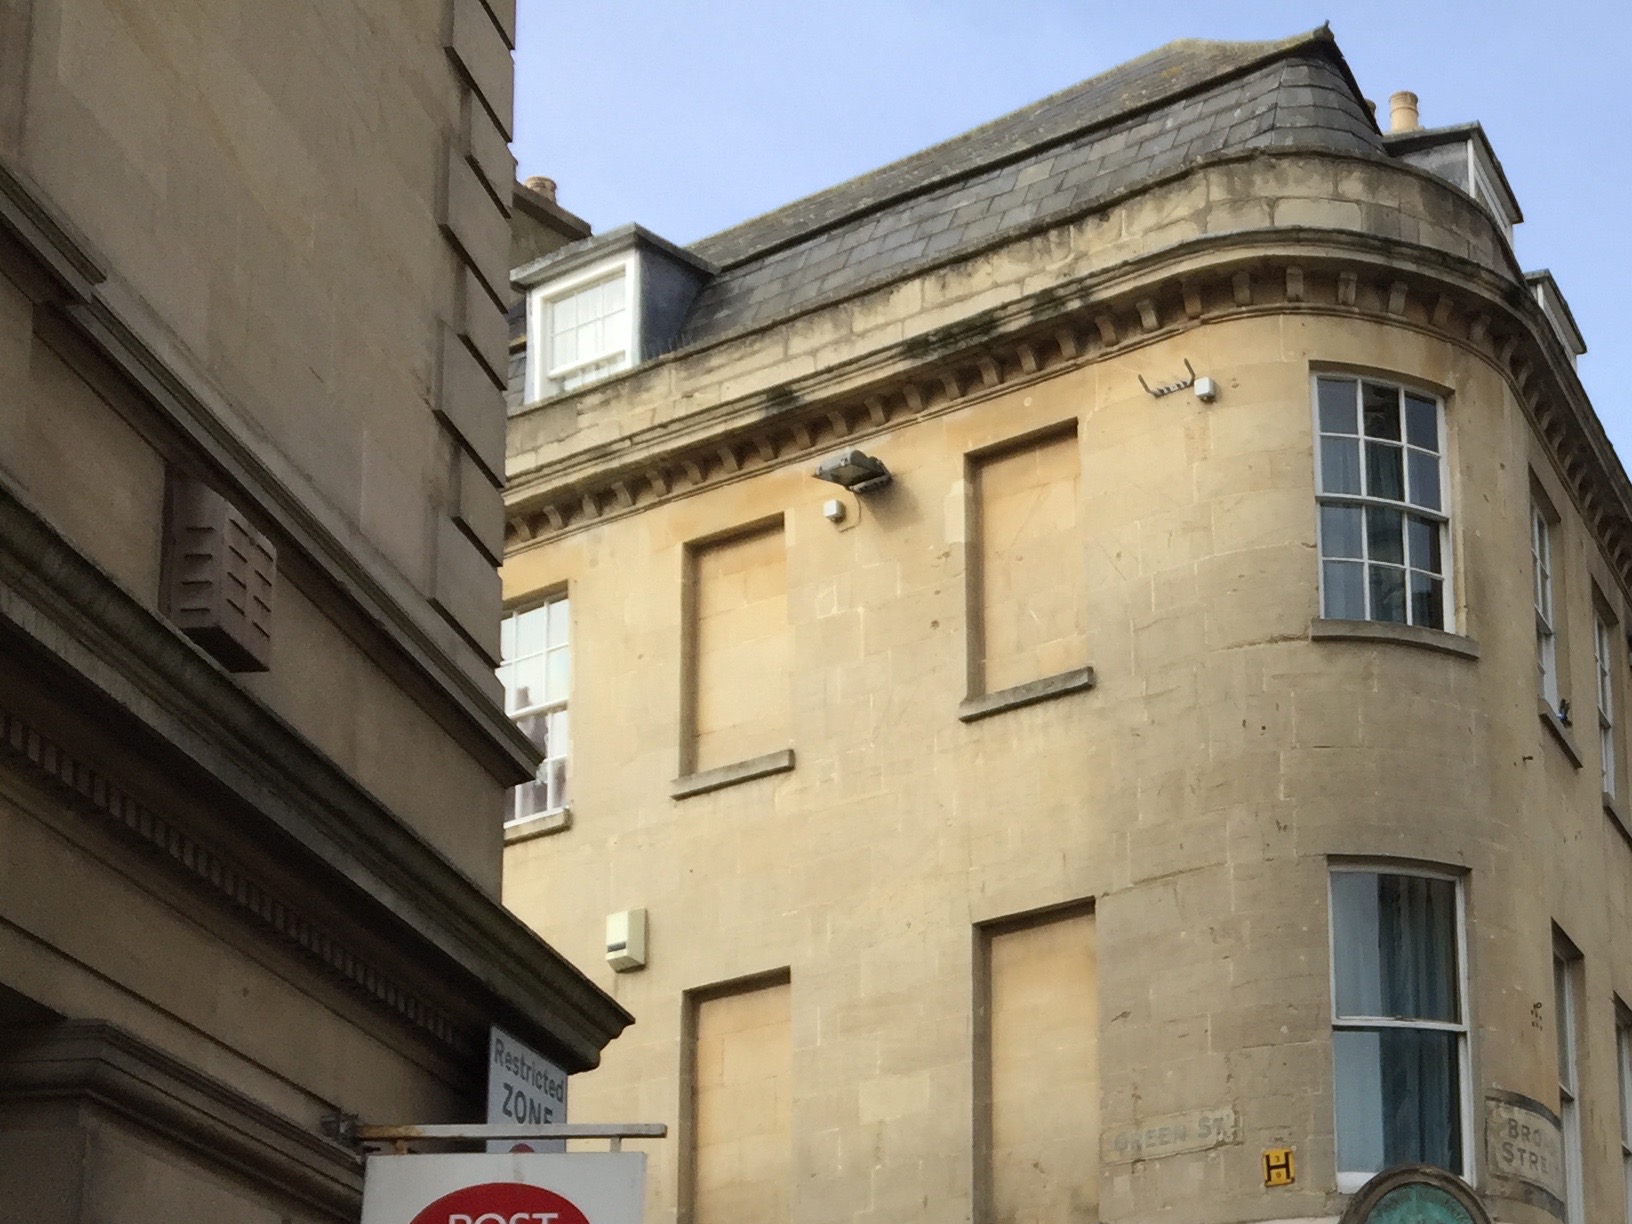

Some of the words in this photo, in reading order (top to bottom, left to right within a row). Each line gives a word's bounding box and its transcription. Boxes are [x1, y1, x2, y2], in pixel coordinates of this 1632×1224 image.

[494, 1038, 564, 1103] Restricted
[502, 1082, 553, 1124] ZONE
[1266, 1152, 1290, 1181] H
